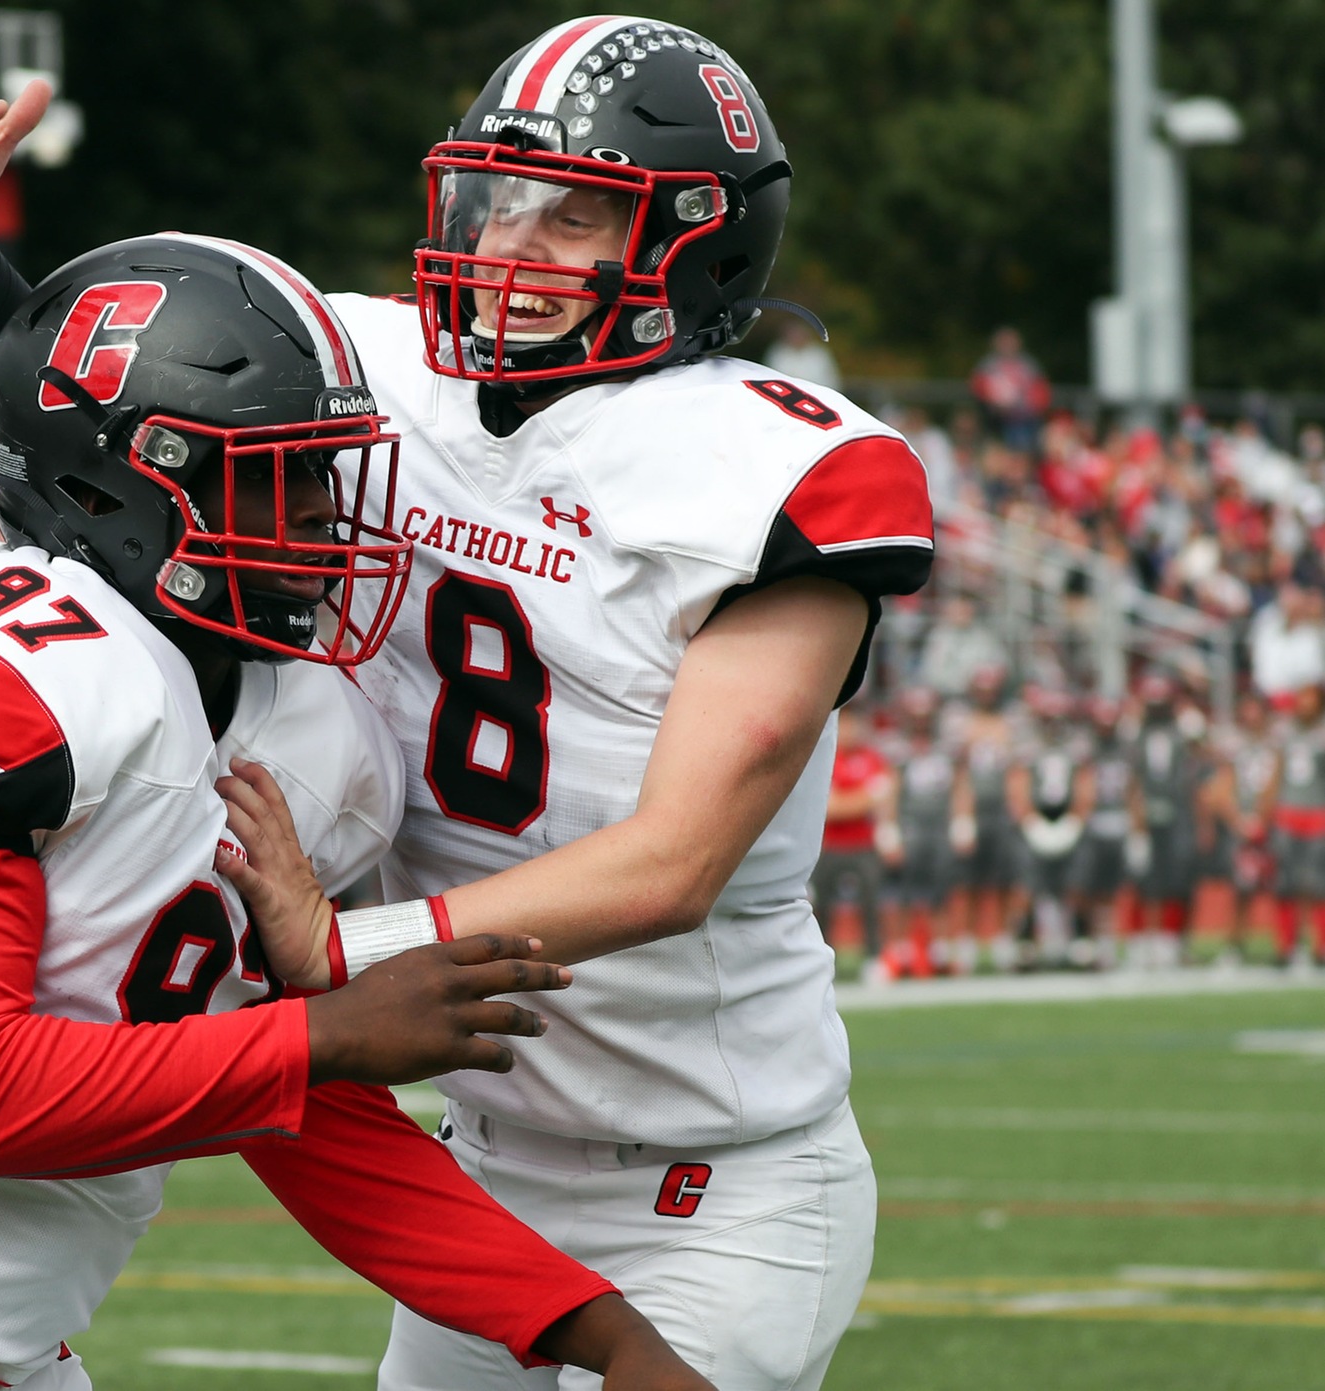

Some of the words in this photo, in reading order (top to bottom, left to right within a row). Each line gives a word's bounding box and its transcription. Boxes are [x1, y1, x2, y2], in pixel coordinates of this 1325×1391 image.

[698, 64, 760, 153] 8
[38, 281, 167, 412] C
[743, 380, 842, 430] 8
[402, 507, 576, 583] CATHOLIC
[424, 567, 552, 837] 8
[654, 1162, 712, 1218] C
